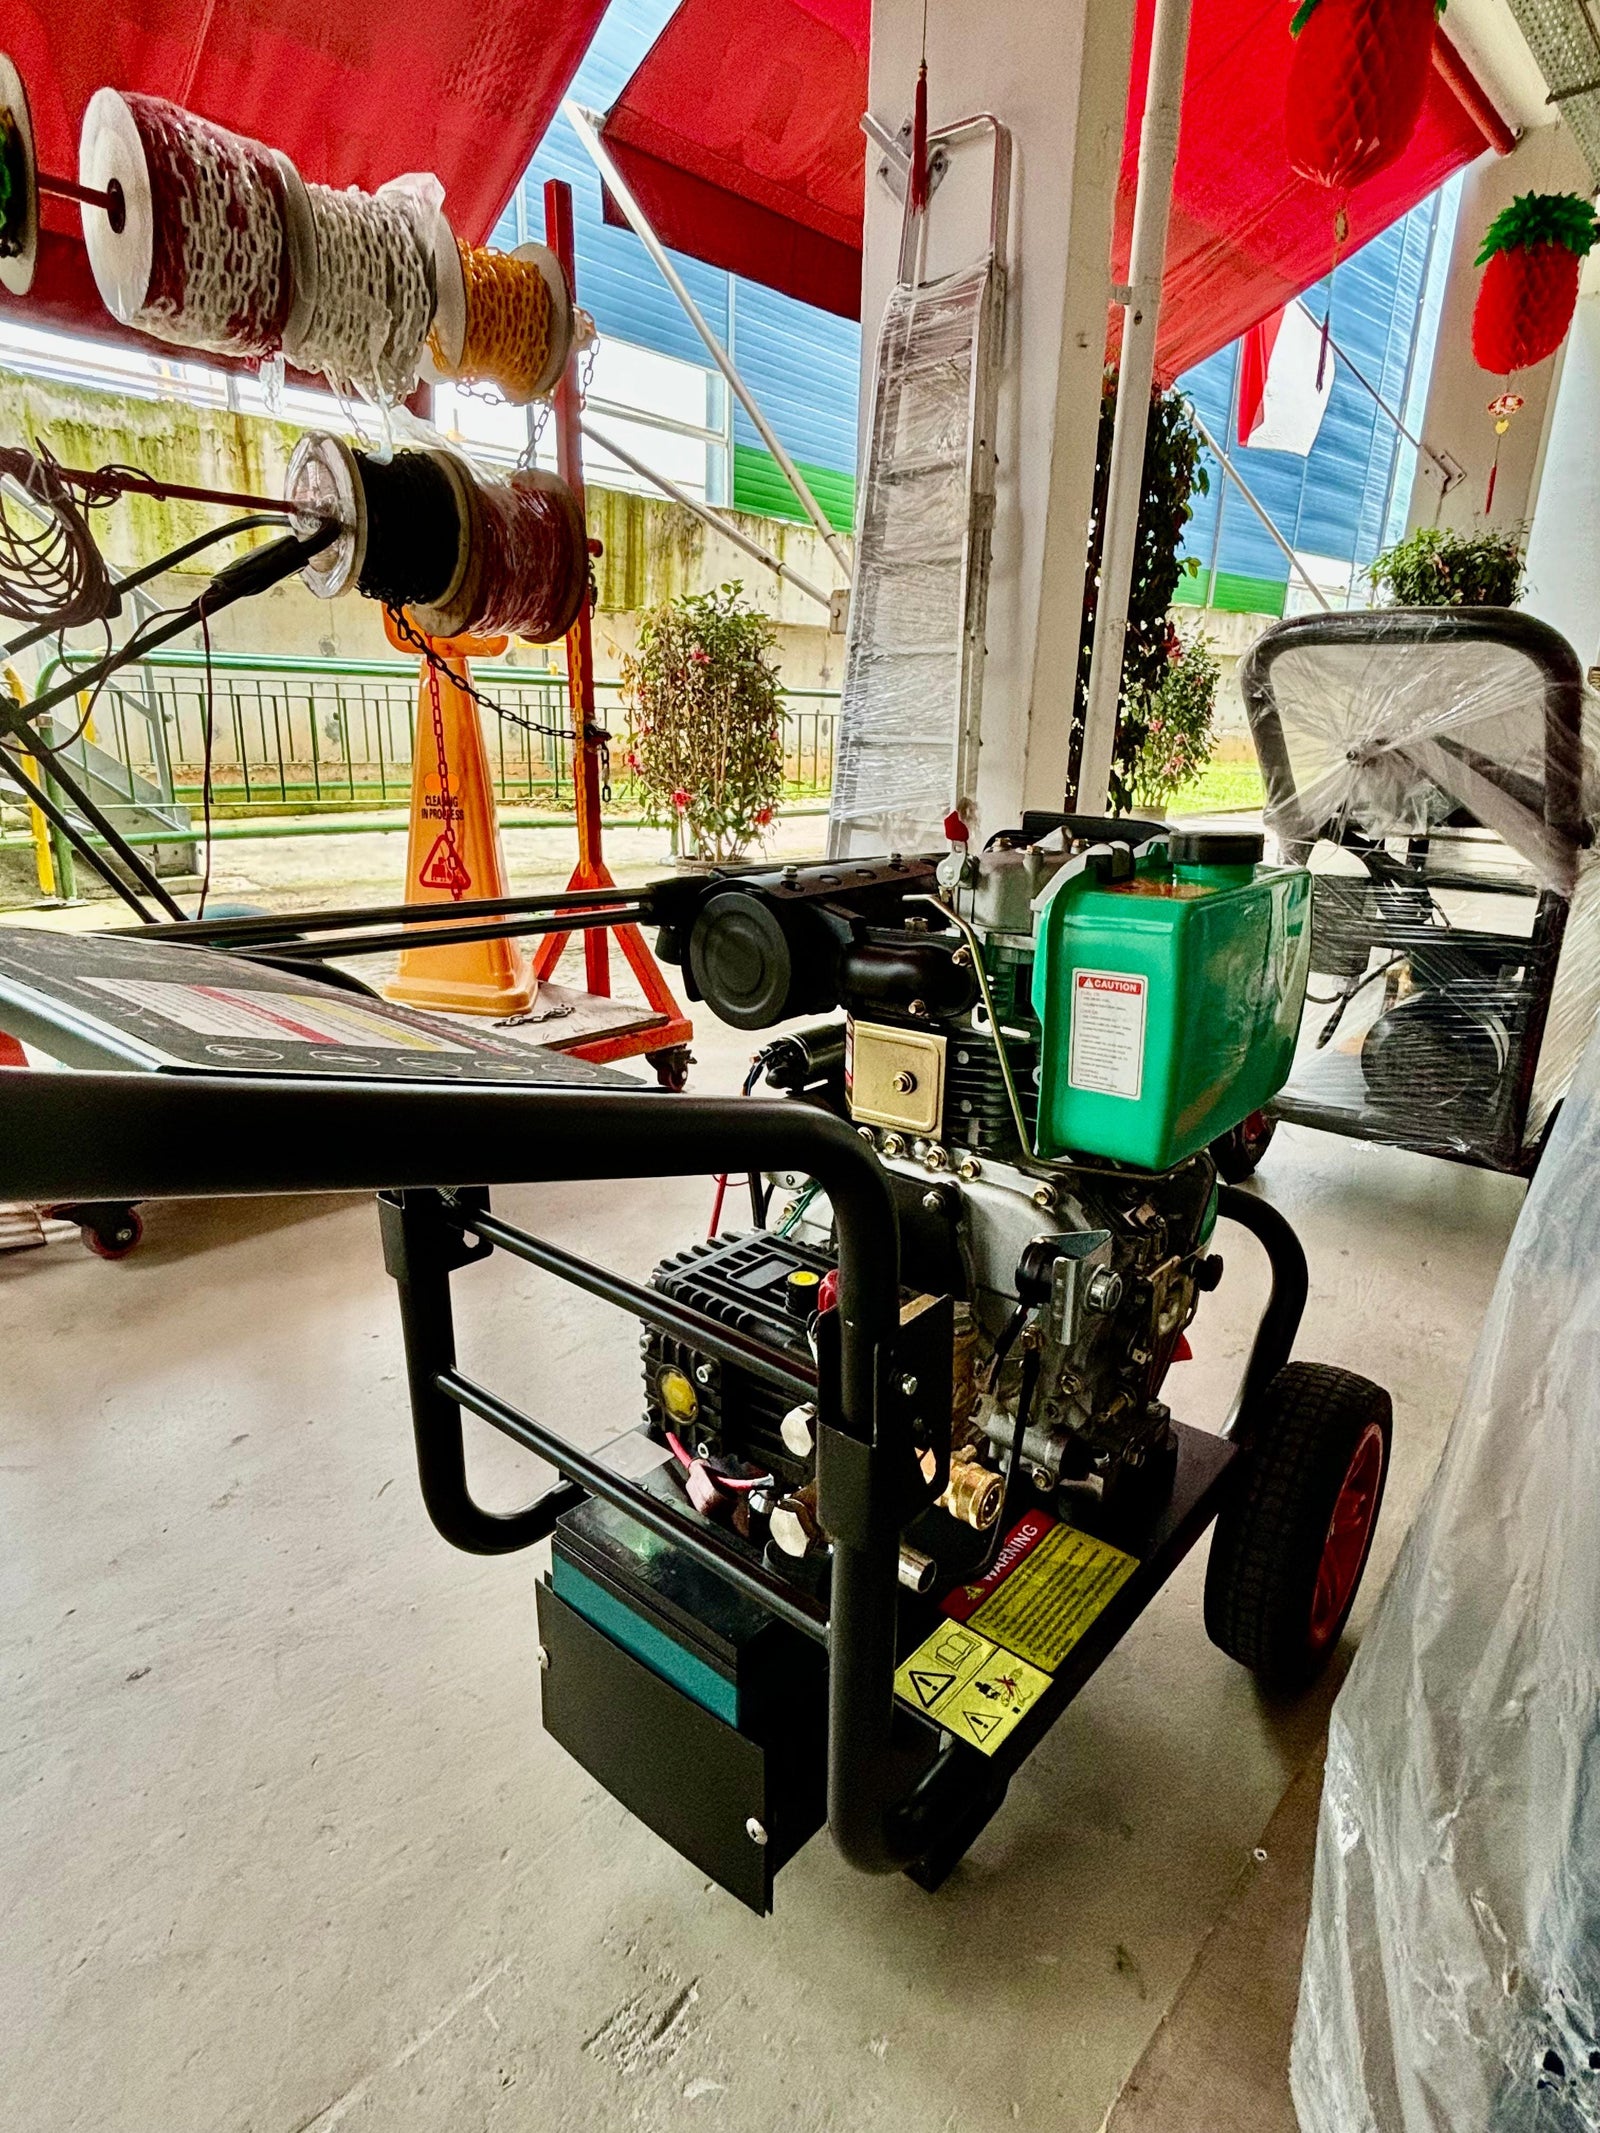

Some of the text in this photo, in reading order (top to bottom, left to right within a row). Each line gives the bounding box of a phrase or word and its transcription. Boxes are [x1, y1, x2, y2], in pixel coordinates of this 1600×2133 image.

[421, 808, 429, 819] IN
[1094, 979, 1137, 993] CAUTION
[983, 1524, 1038, 1581] WARNING
